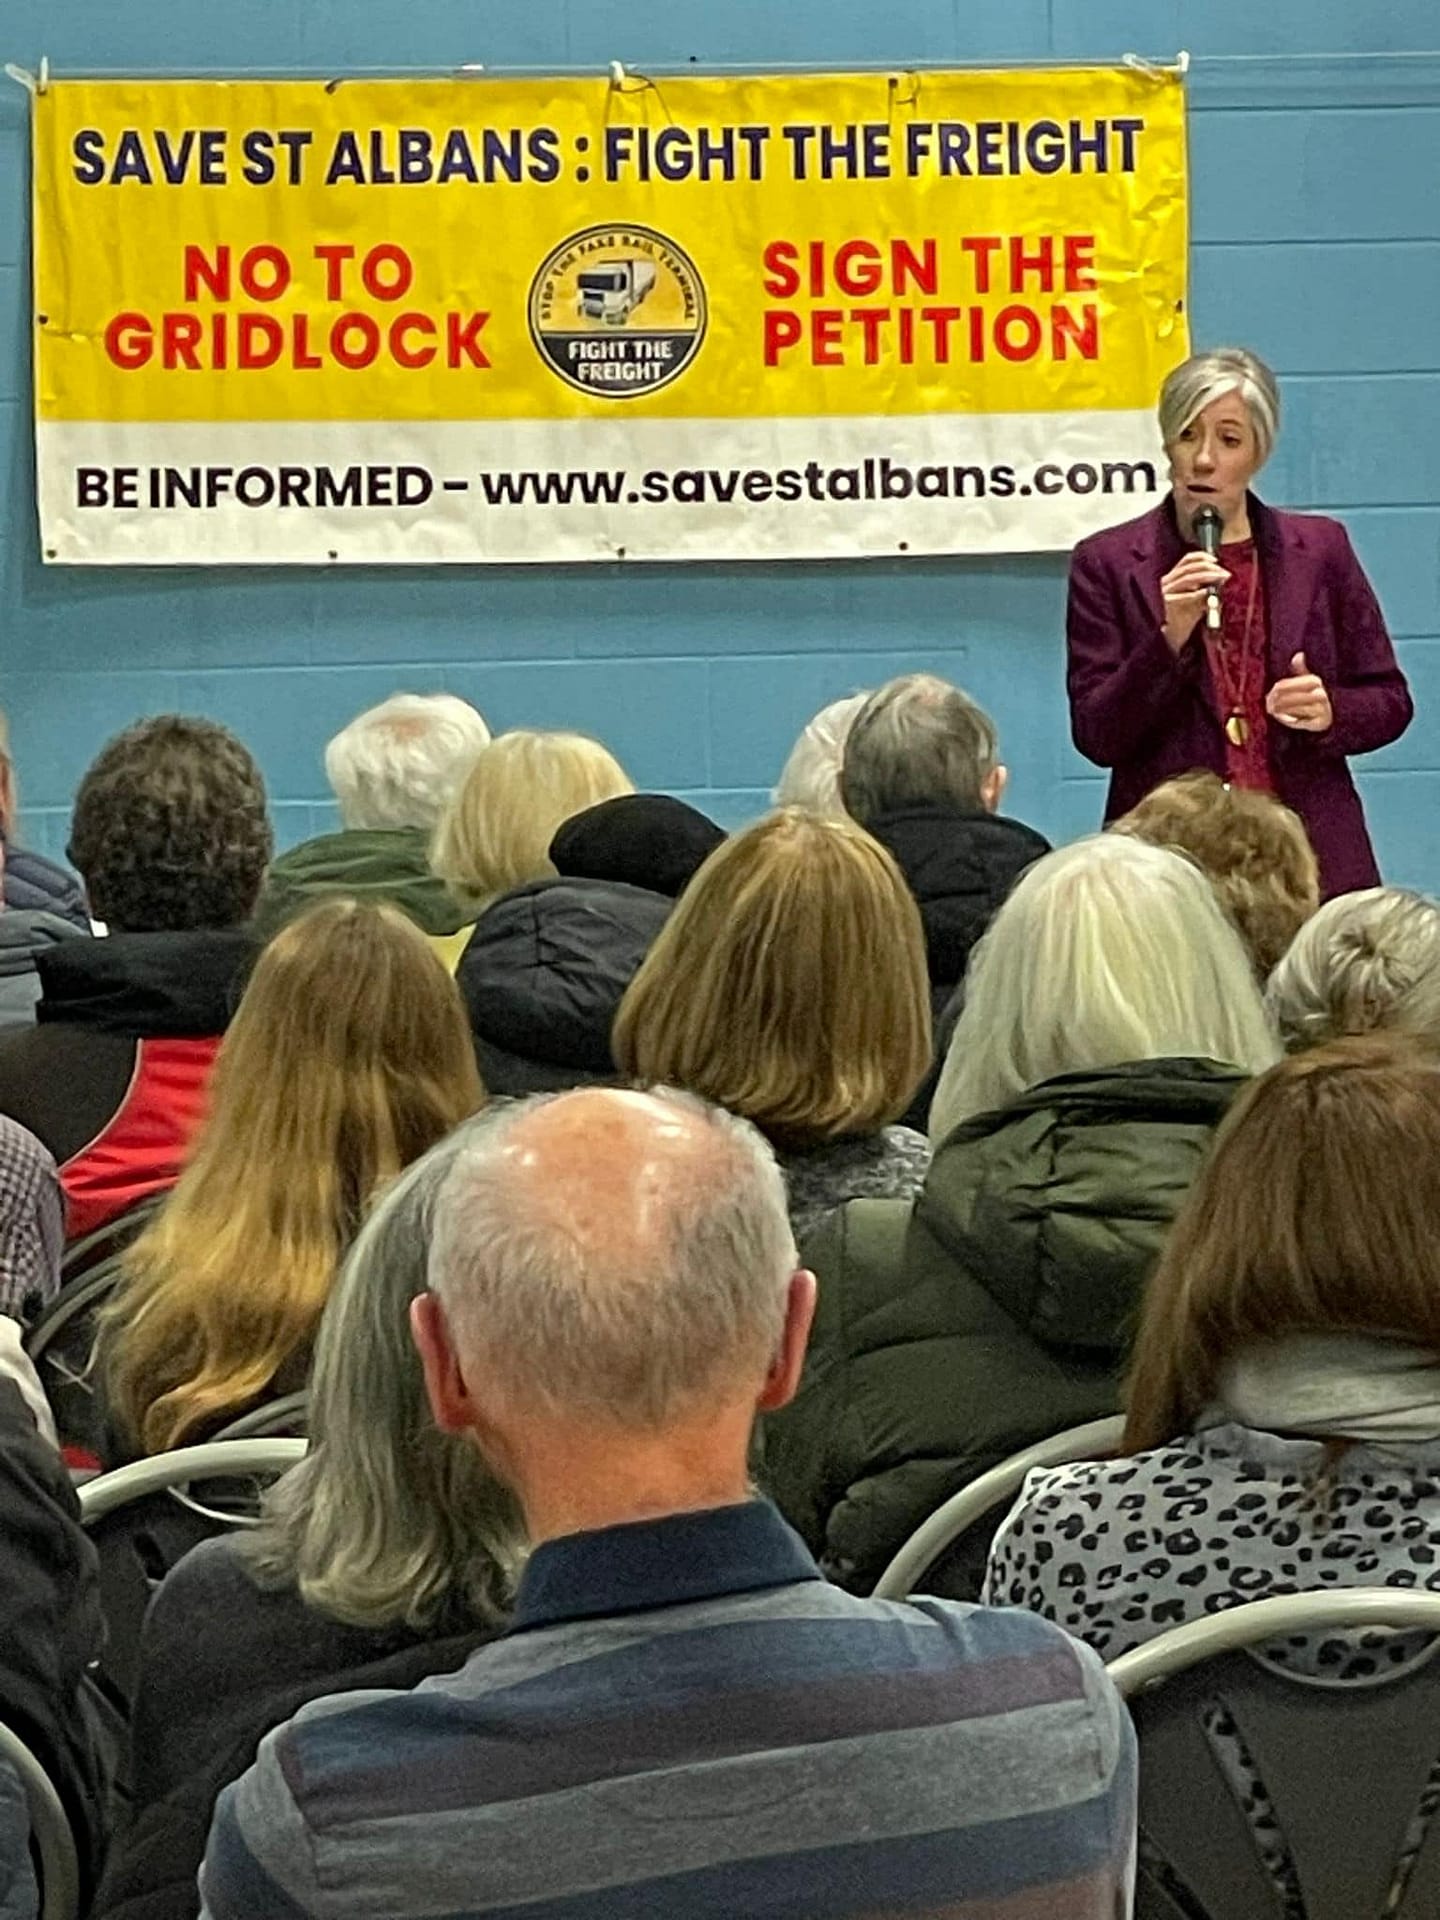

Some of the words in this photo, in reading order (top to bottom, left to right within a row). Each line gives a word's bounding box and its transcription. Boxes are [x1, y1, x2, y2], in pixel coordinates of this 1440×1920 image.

[73, 130, 228, 185] SAVE
[241, 130, 312, 185] ST
[325, 128, 560, 186] ALBANS
[605, 126, 769, 182] FIGHT
[783, 124, 890, 180] THE
[905, 119, 1145, 177] FREIGHT
[184, 243, 291, 301] NO
[314, 243, 413, 301] TO
[578, 236, 615, 255] FAKE
[763, 239, 936, 298] SIGN
[961, 235, 1095, 293] THE
[104, 311, 492, 370] GRIDLOCK
[568, 340, 628, 360] FIGHT
[632, 340, 674, 359] THE
[763, 304, 1099, 366] PETITION
[577, 362, 664, 381] FREIGHT
[76, 467, 138, 507] BE
[149, 466, 433, 507] INFORMED
[481, 458, 1157, 504] www.savestalbans.com
